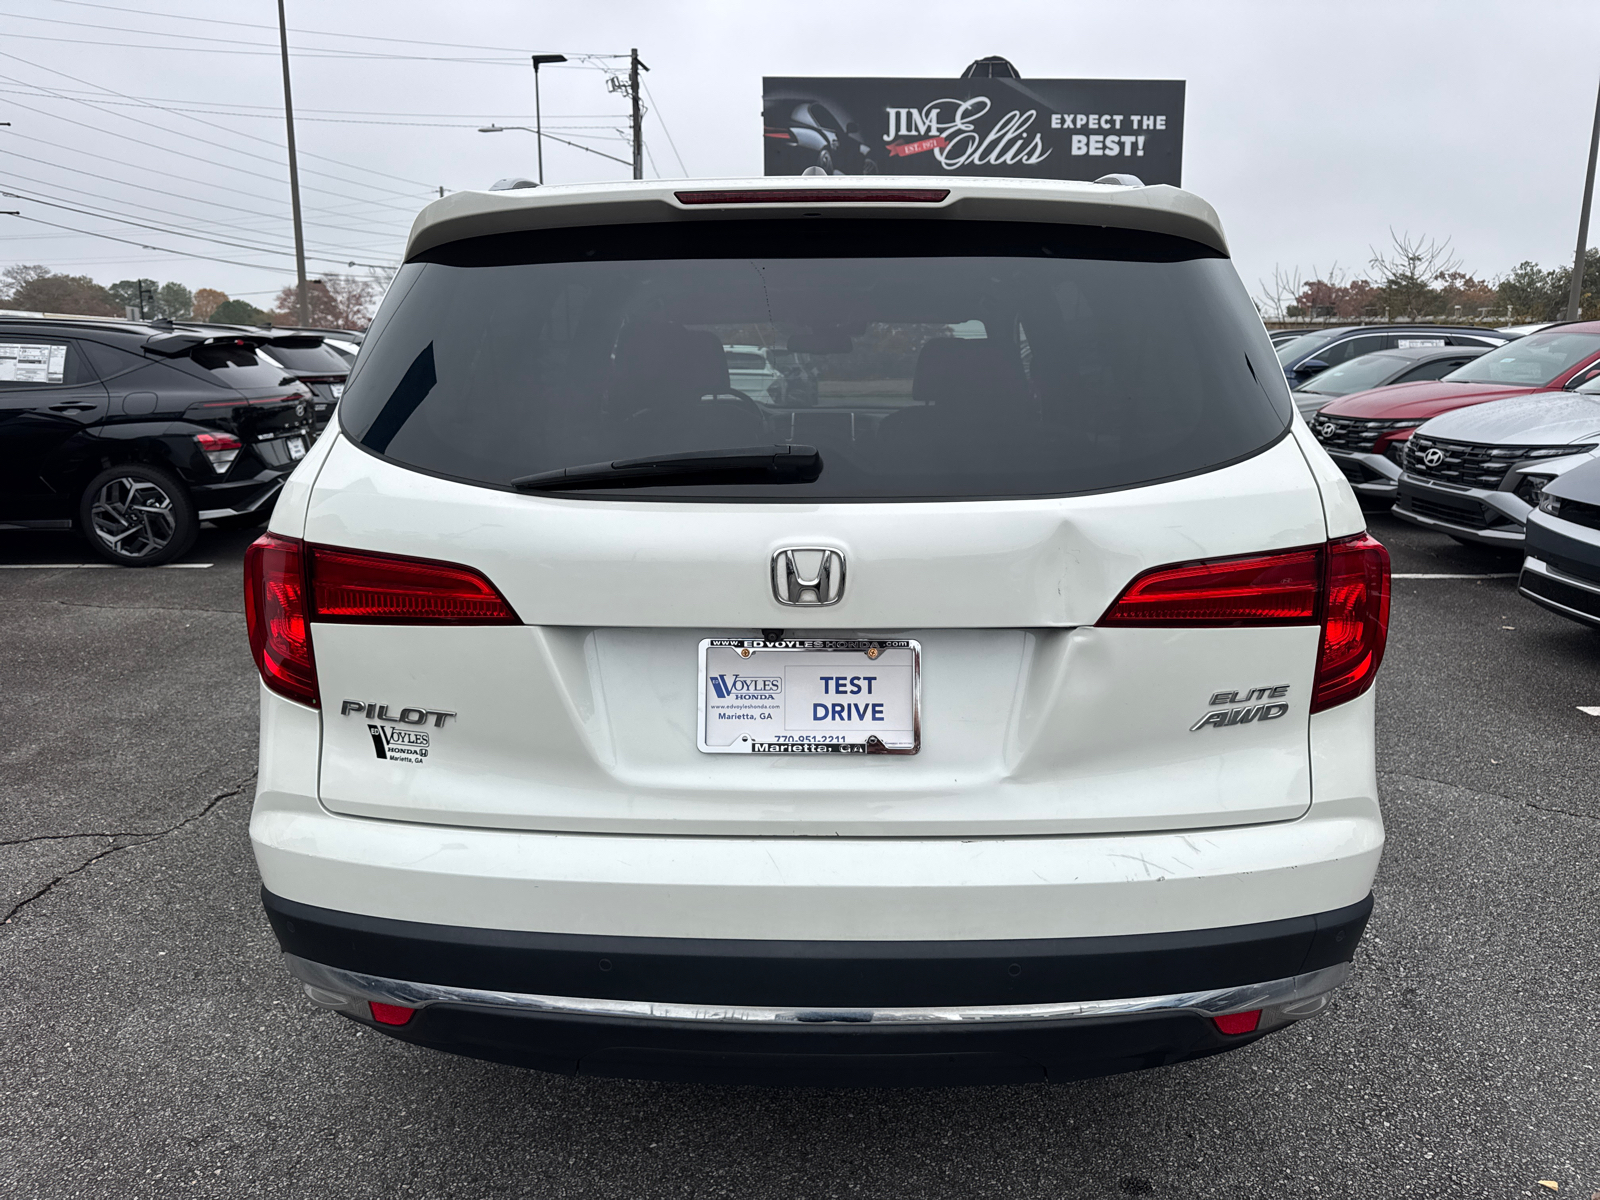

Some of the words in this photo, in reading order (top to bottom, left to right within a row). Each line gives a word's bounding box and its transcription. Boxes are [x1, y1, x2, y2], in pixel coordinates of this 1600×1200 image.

[1051, 114, 1124, 129] EXPECT
[1130, 115, 1166, 130] THE
[883, 108, 940, 141] JIM
[922, 96, 1053, 170] Ellis
[904, 144, 922, 154] EST.
[923, 140, 938, 150] 1971
[1071, 134, 1145, 156] BEST!
[820, 676, 877, 694] TEST
[1209, 684, 1290, 706] ELITE
[341, 699, 457, 728] PILOT
[718, 712, 757, 721] Marietta,
[759, 712, 773, 720] GA
[813, 703, 885, 721] DRIVE
[1189, 701, 1289, 731] AWD
[387, 747, 419, 756] HONDA
[754, 743, 832, 753] Marietta,
[838, 743, 864, 753] GA
[389, 754, 414, 763] Marietta,
[414, 756, 423, 764] GA
